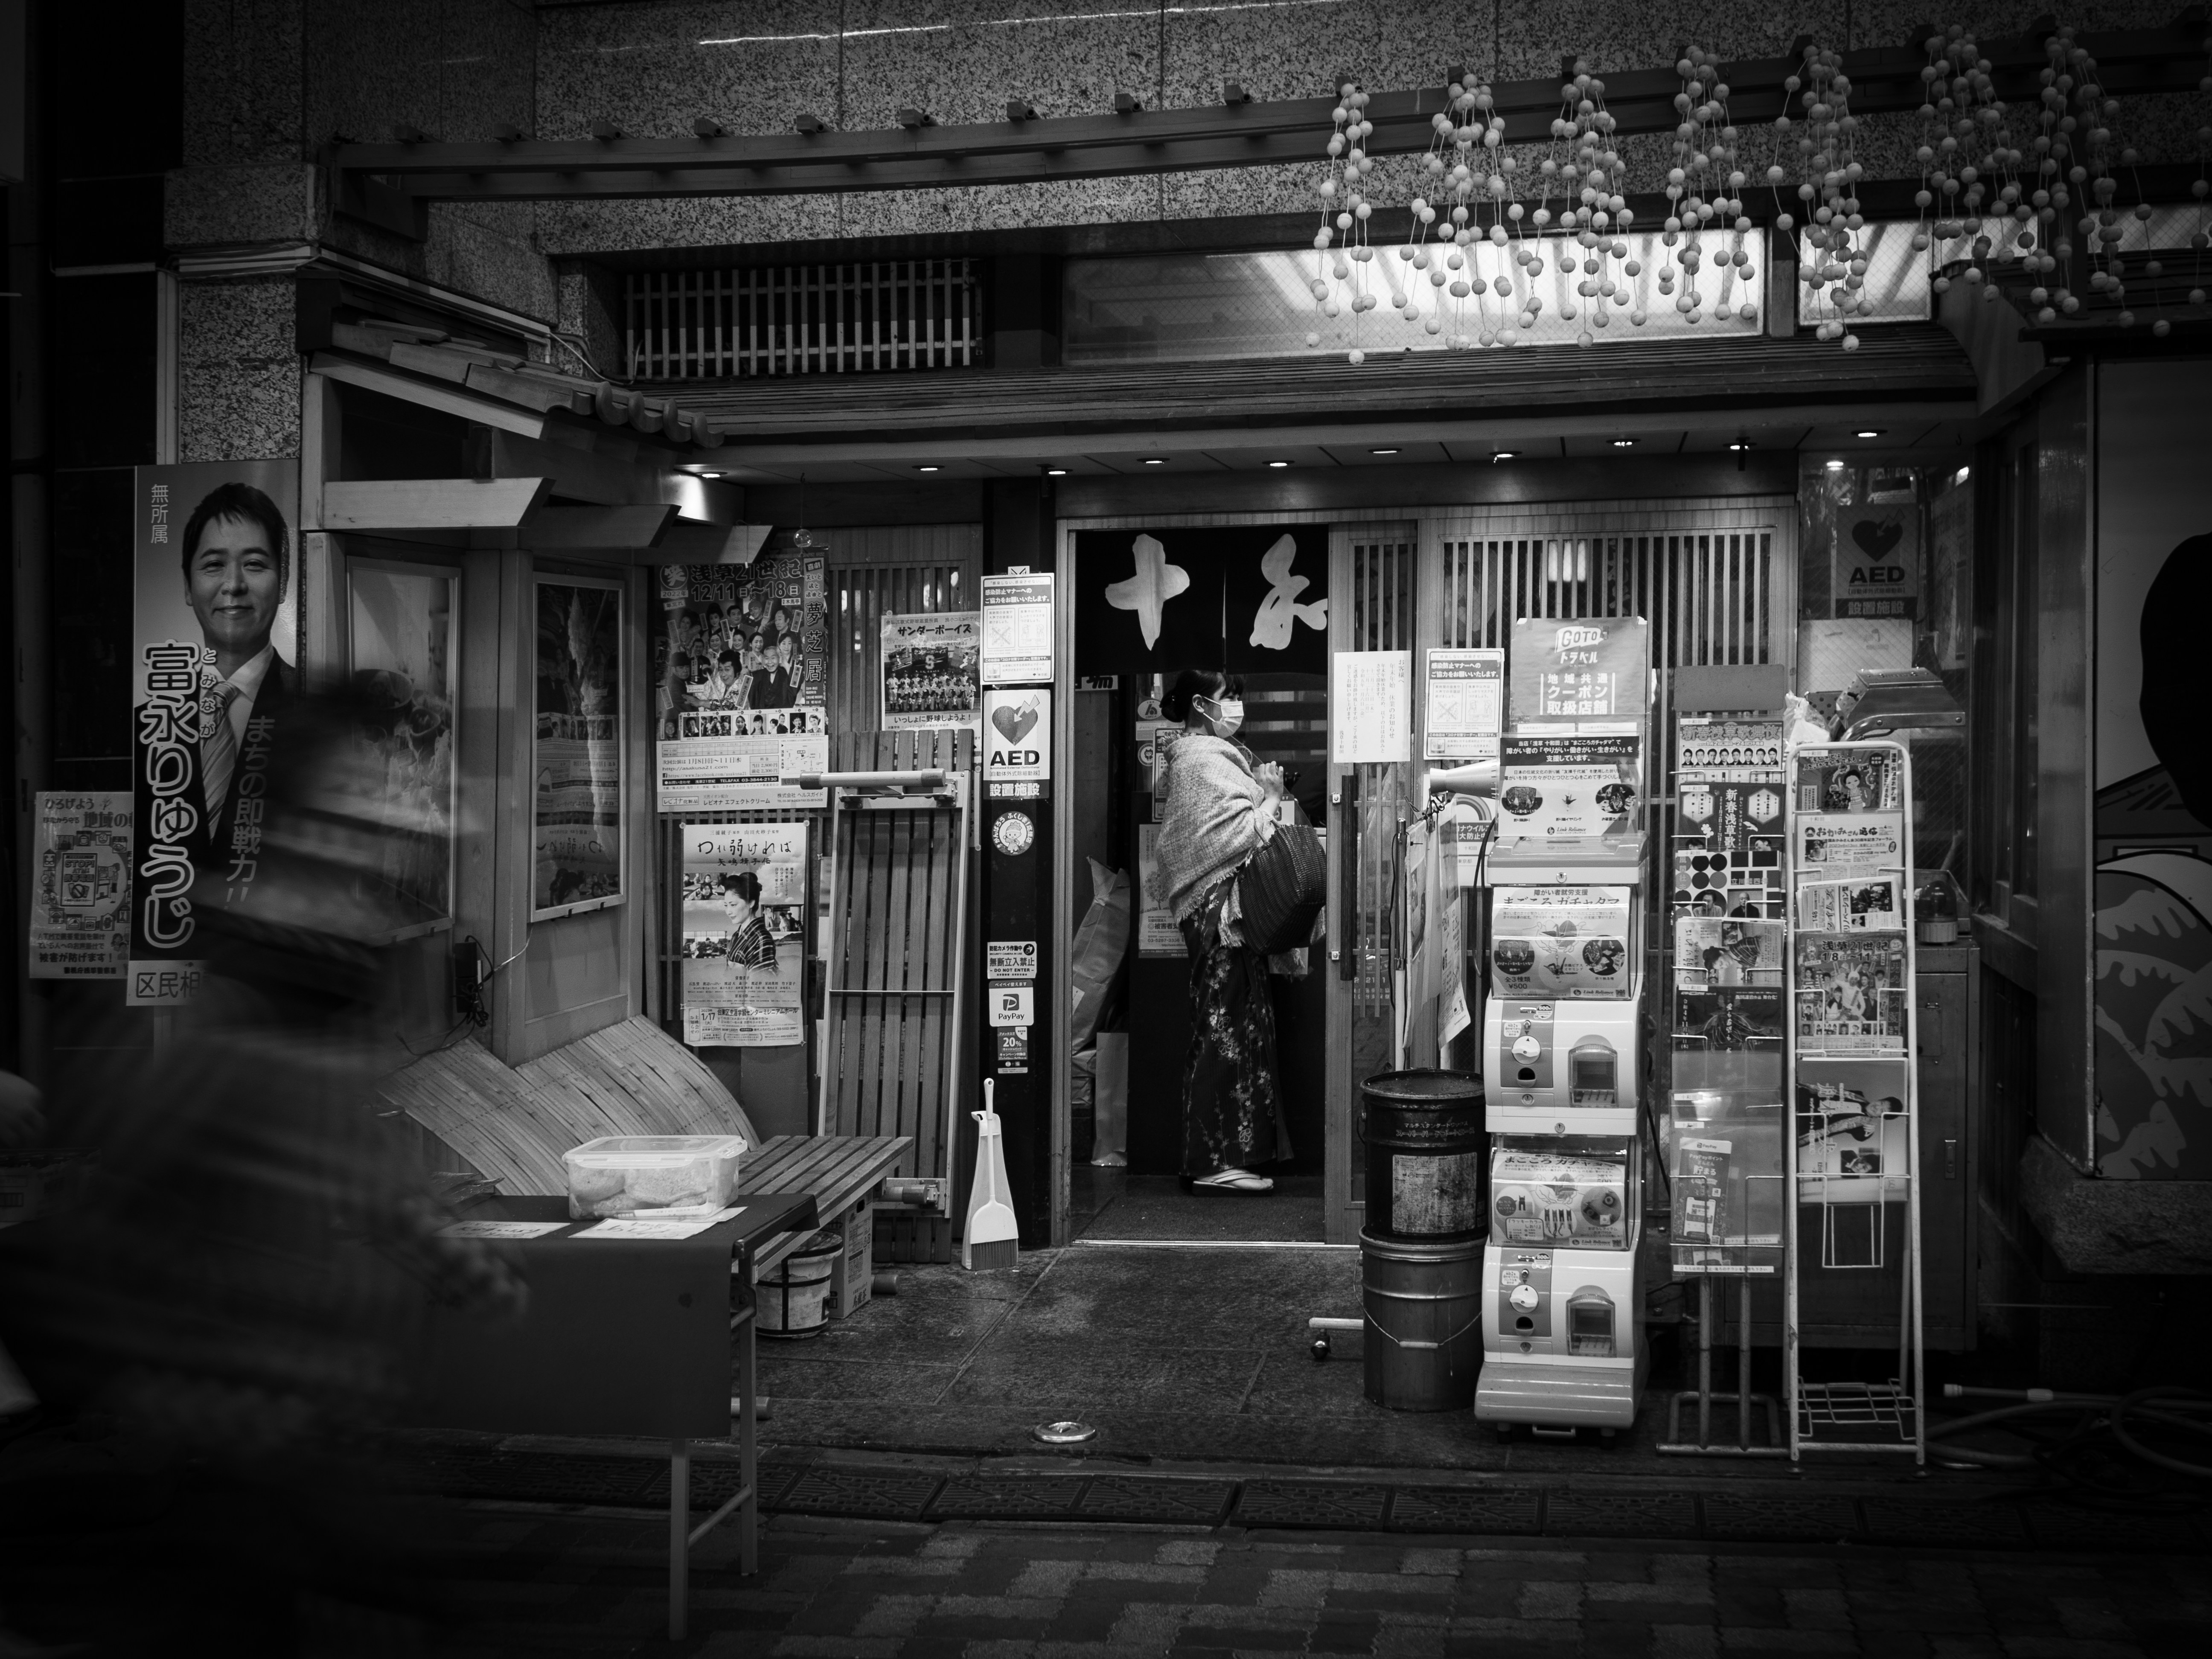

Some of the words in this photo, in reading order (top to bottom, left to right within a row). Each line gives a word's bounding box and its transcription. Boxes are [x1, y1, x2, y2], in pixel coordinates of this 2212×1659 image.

[151, 483, 169, 544] 無所属
[691, 559, 803, 582] 浅草21世紀
[1850, 566, 1905, 583] AED
[985, 596, 1049, 604] ご協力をお願いいたします。
[1848, 601, 1904, 616] 設置施設
[898, 624, 972, 636] サンダーボーイズ
[806, 602, 823, 682] 夢芝居
[1560, 652, 1598, 664] トラベル
[1548, 673, 1608, 684] 地域共通
[200, 648, 218, 739] とみなが
[1548, 685, 1608, 699] クーポン
[1547, 700, 1608, 715] 取扱店舗
[894, 714, 971, 723] いっしょに野球しようよ！
[990, 750, 1040, 766] AED
[140, 640, 199, 949] 富永りゅうじ
[989, 783, 1040, 797] 設置施設
[1724, 789, 1738, 852] 新春浅草歌
[1822, 940, 1889, 951] 浅草21世紀
[990, 958, 1035, 966] 無断立入禁止
[1003, 1037, 1022, 1047] 20%
[1693, 1165, 1716, 1176] 貯まる
